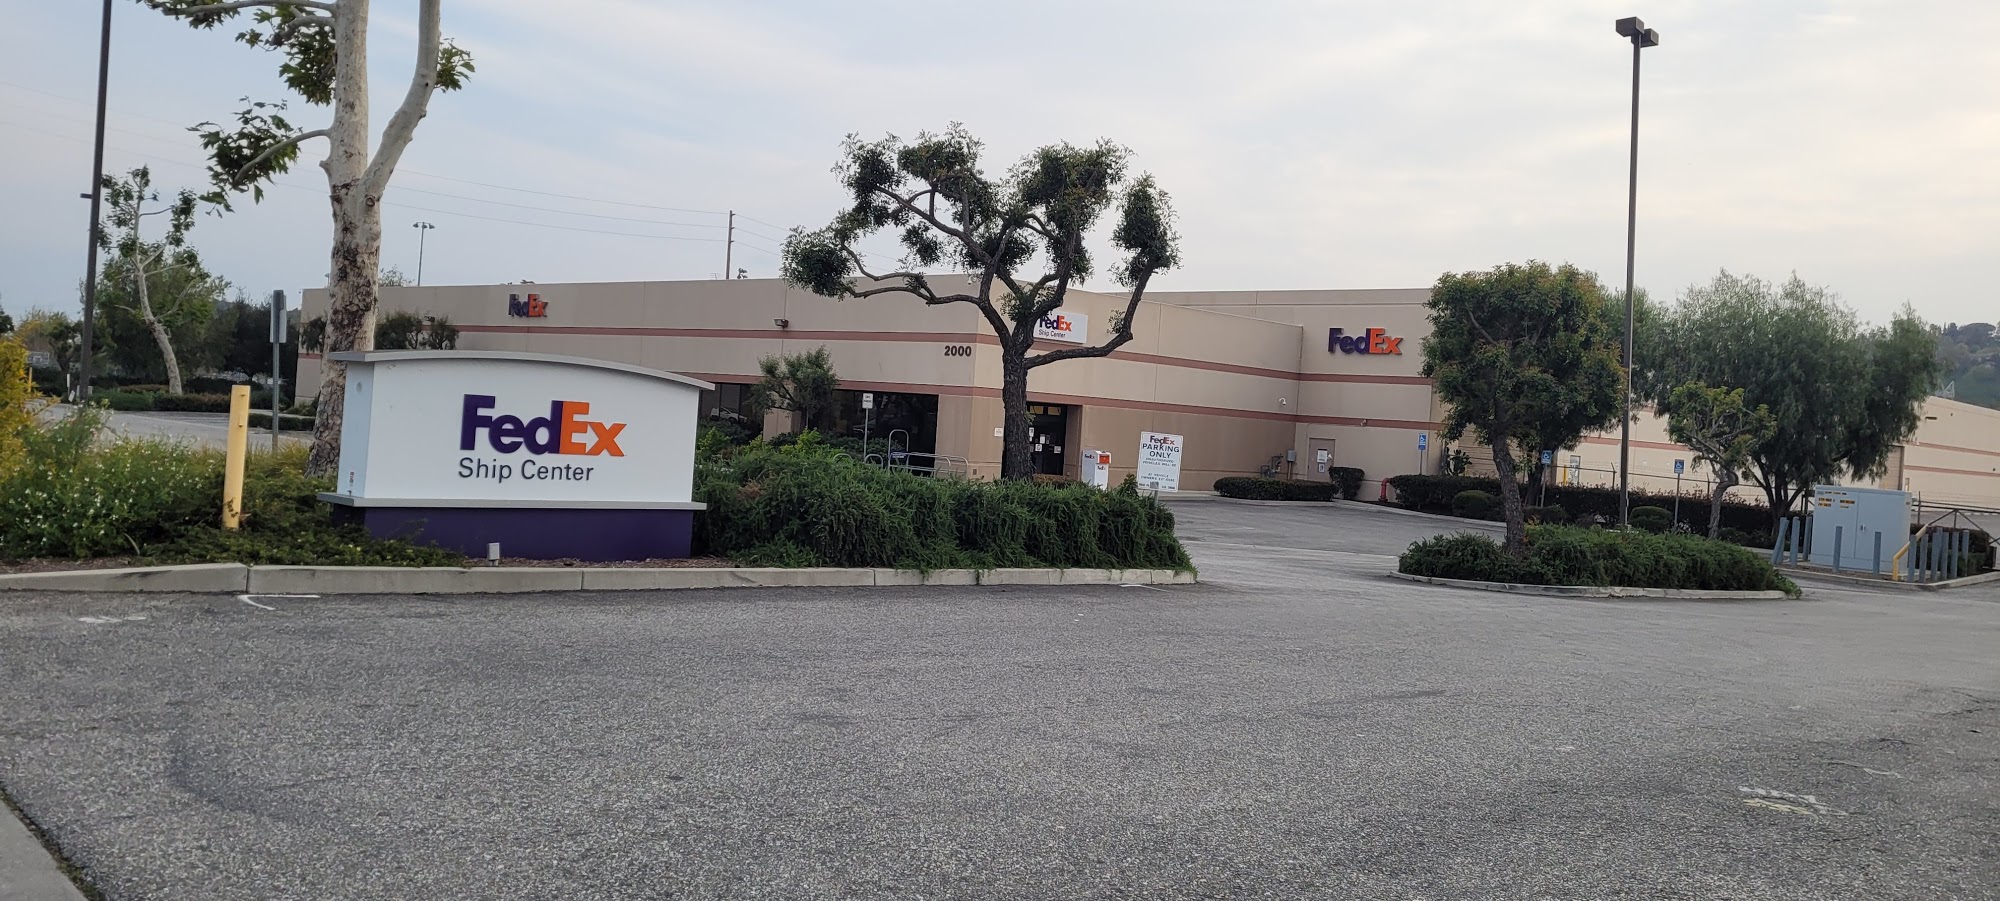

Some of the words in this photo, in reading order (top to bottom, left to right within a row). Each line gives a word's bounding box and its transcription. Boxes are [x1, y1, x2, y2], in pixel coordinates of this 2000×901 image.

[508, 293, 549, 317] FedEx
[1039, 314, 1073, 332] FedEx
[1038, 329, 1049, 337] Ship
[1328, 328, 1404, 356] FedEx
[944, 345, 972, 357] 2000
[460, 393, 627, 457] FedEx
[1150, 435, 1175, 445] FedEx
[1142, 443, 1180, 453] PARKING
[1149, 450, 1172, 459] ONLY
[458, 457, 512, 483] Ship
[520, 459, 594, 481] Center
